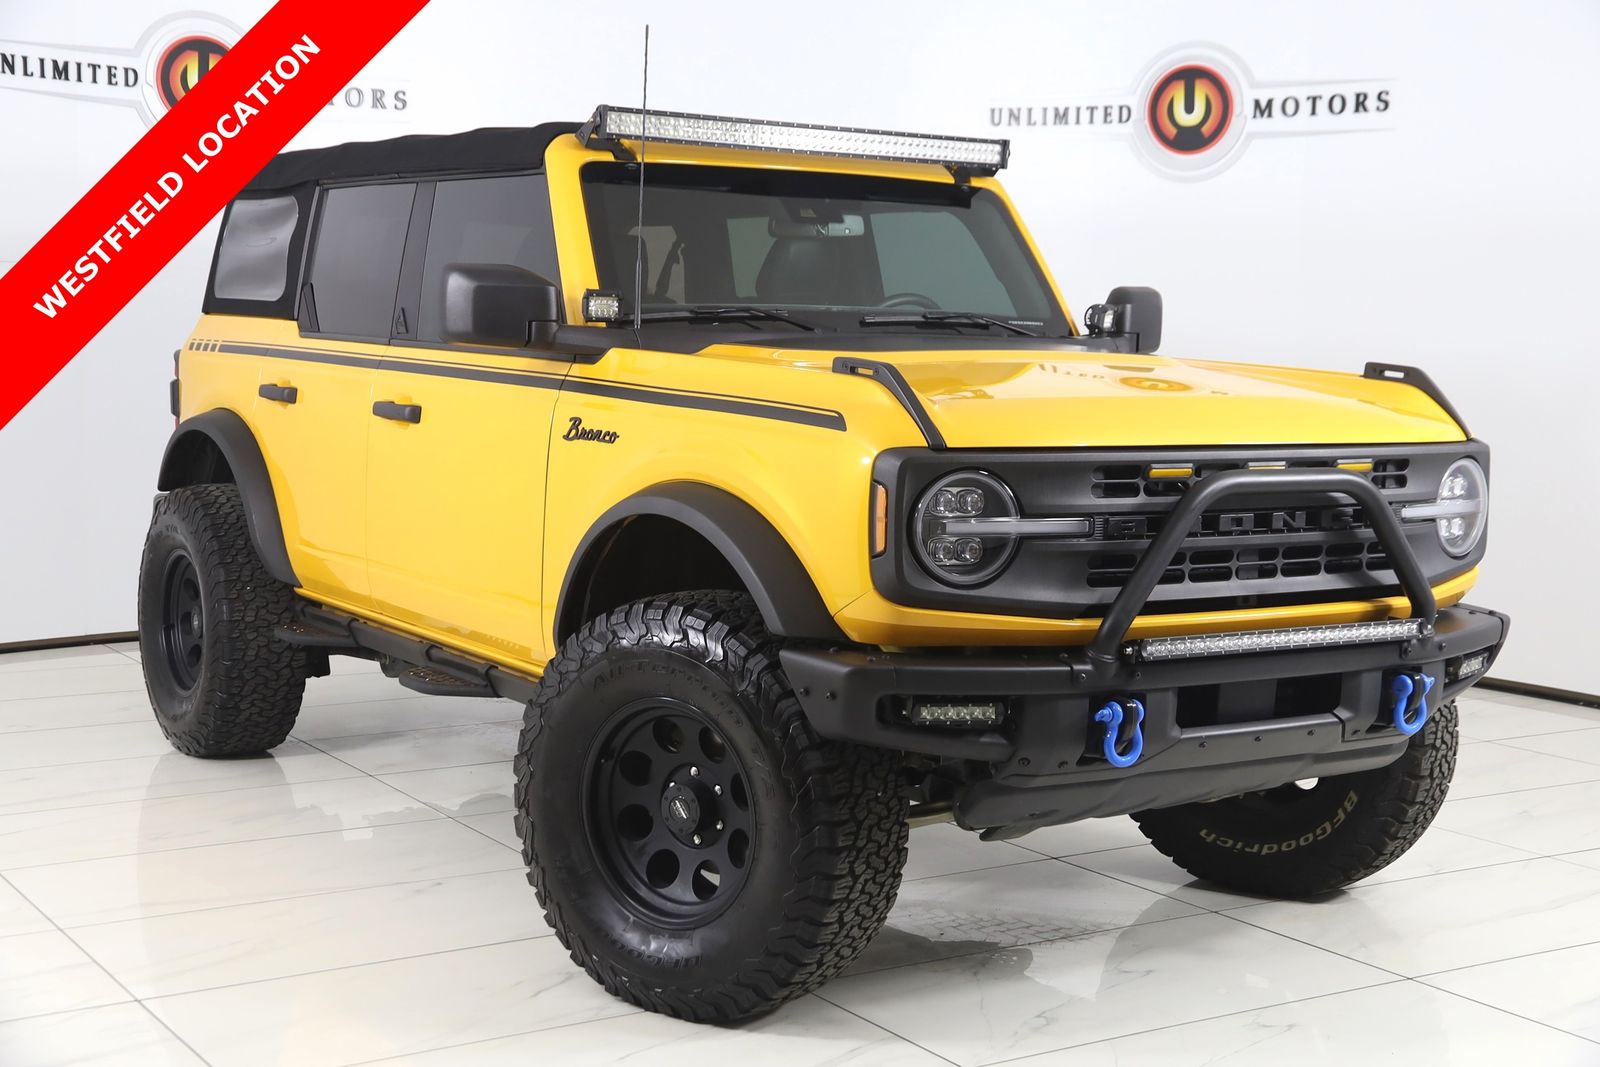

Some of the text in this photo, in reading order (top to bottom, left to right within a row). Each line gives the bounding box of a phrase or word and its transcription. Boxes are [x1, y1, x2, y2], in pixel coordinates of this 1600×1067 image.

[0, 53, 408, 111] NLIMITED ORS
[989, 104, 1132, 126] UNLIMITED
[1252, 90, 1391, 119] MOTORS
[562, 416, 620, 444] Bronco
[1199, 789, 1359, 856] BFGoodrich
